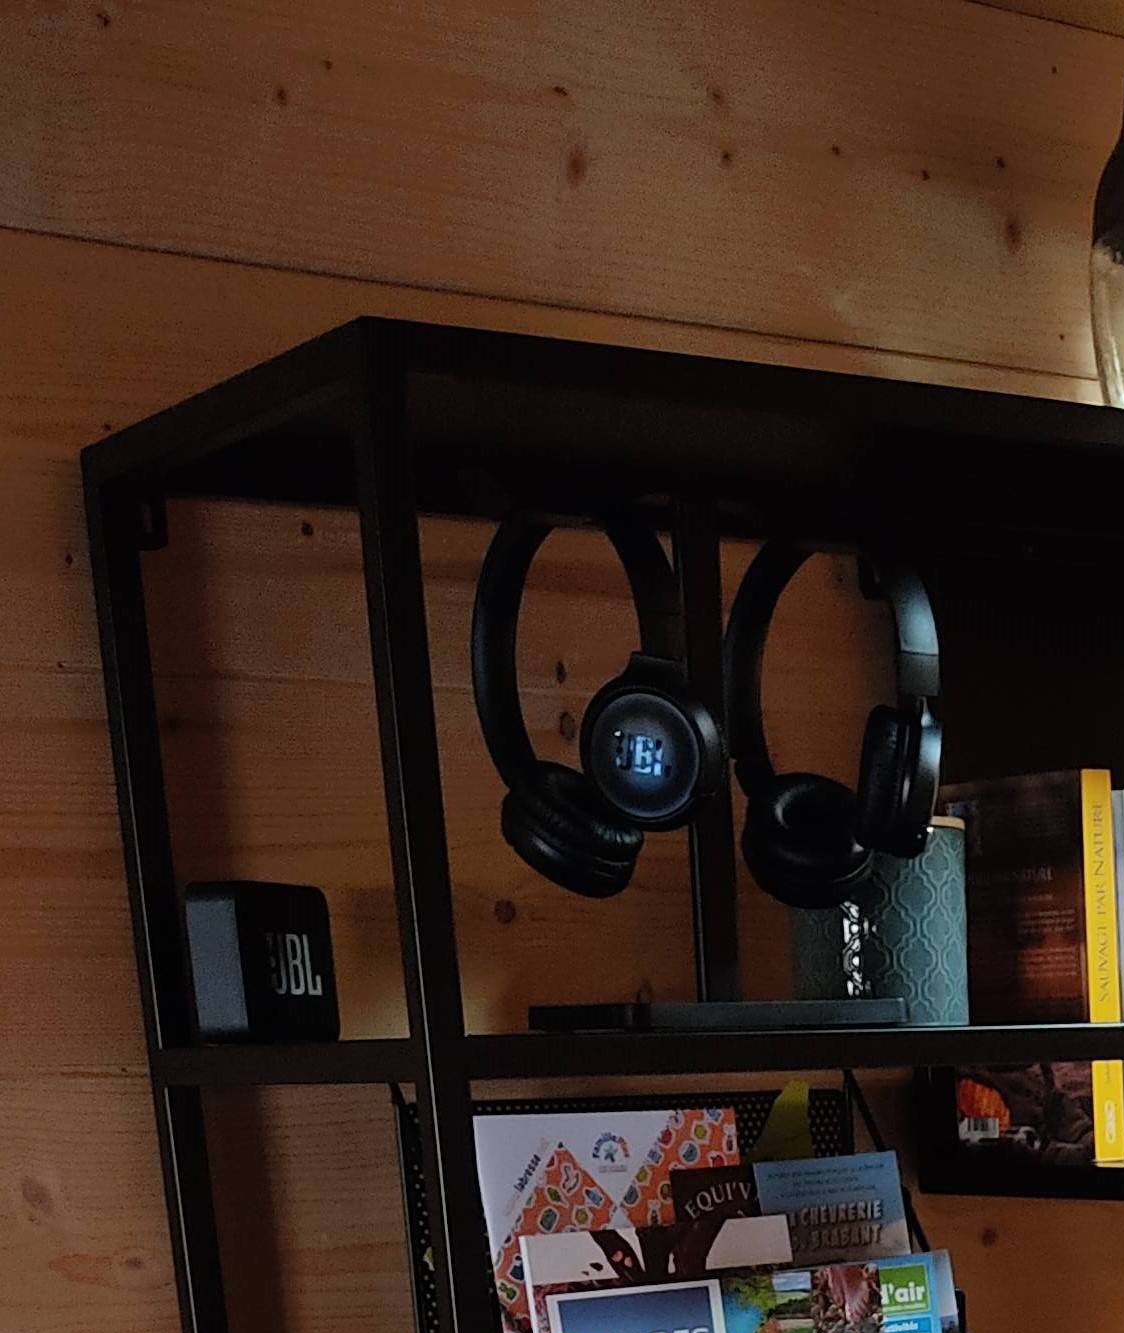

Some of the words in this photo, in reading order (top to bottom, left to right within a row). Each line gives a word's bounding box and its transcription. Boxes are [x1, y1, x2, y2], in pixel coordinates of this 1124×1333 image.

[1092, 803, 1105, 877] NATURE
[1095, 883, 1107, 916] PAR
[270, 933, 323, 996] JBL
[1096, 925, 1111, 1003] SAUVAGE
[684, 1181, 752, 1220] EQUI'V
[800, 1200, 881, 1227] CHEVRERIE
